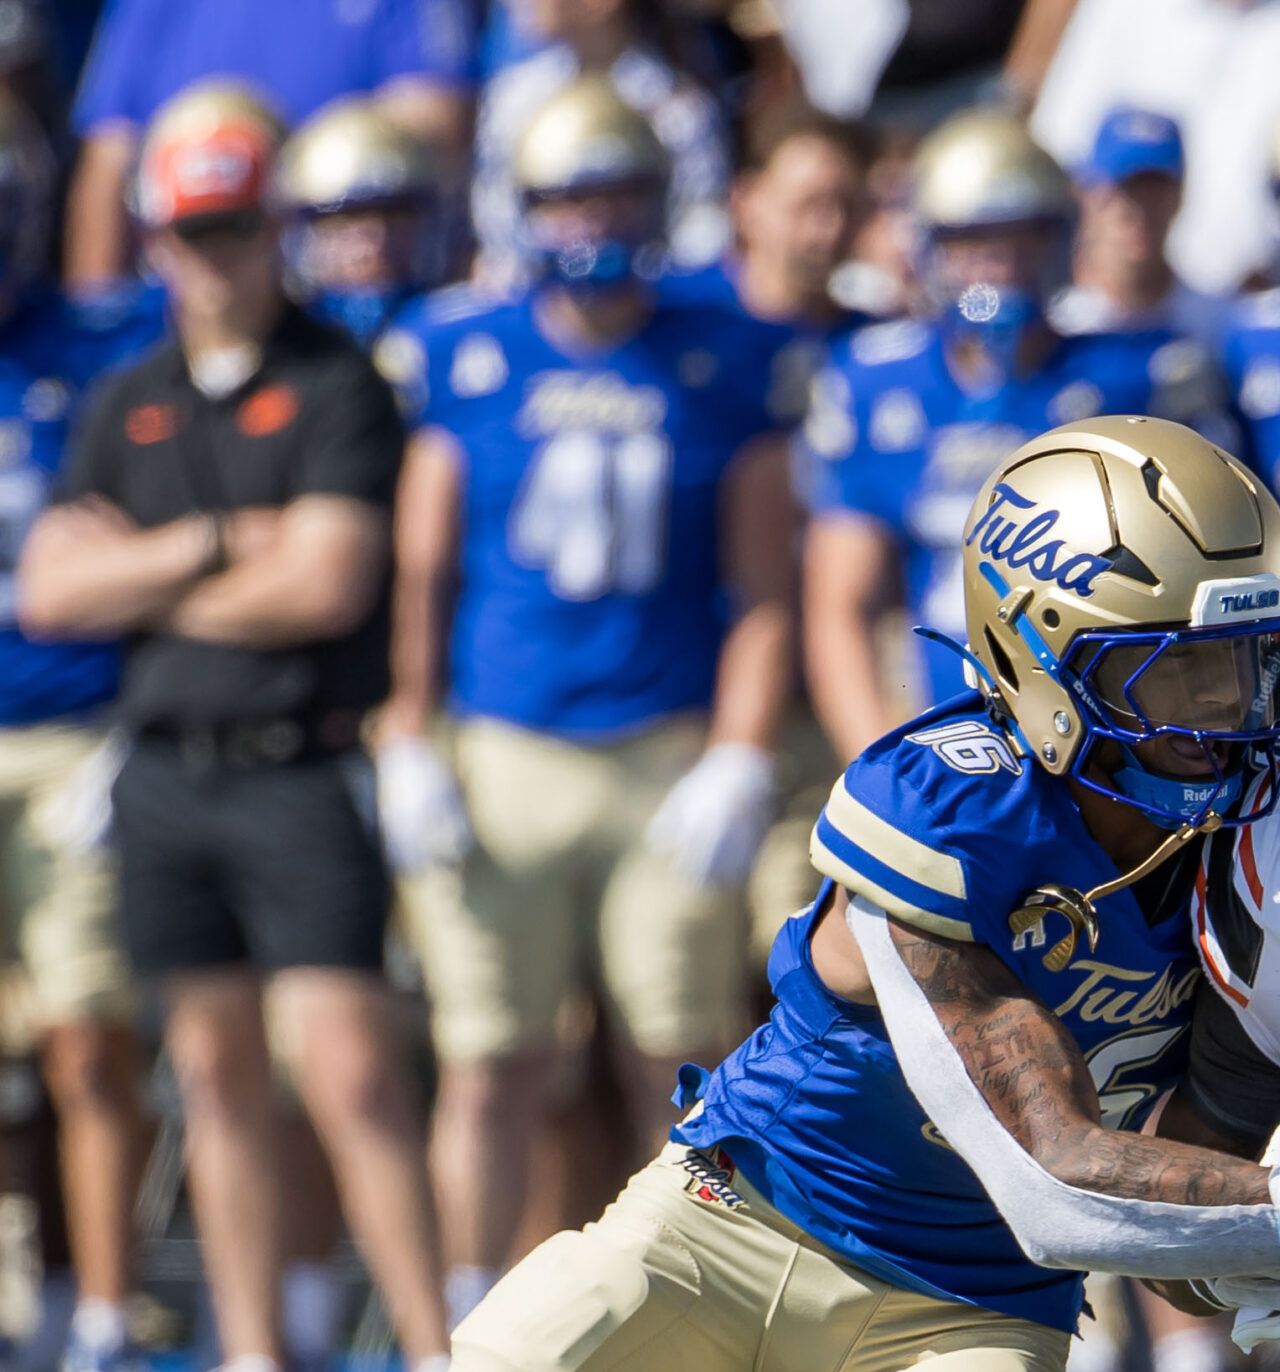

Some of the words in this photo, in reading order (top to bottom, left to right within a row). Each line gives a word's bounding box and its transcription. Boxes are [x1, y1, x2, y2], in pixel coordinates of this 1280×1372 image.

[508, 432, 674, 600] 41
[965, 482, 1116, 598] Tulsa
[903, 721, 1023, 776] 16
[1054, 960, 1201, 1024] Tulsa
